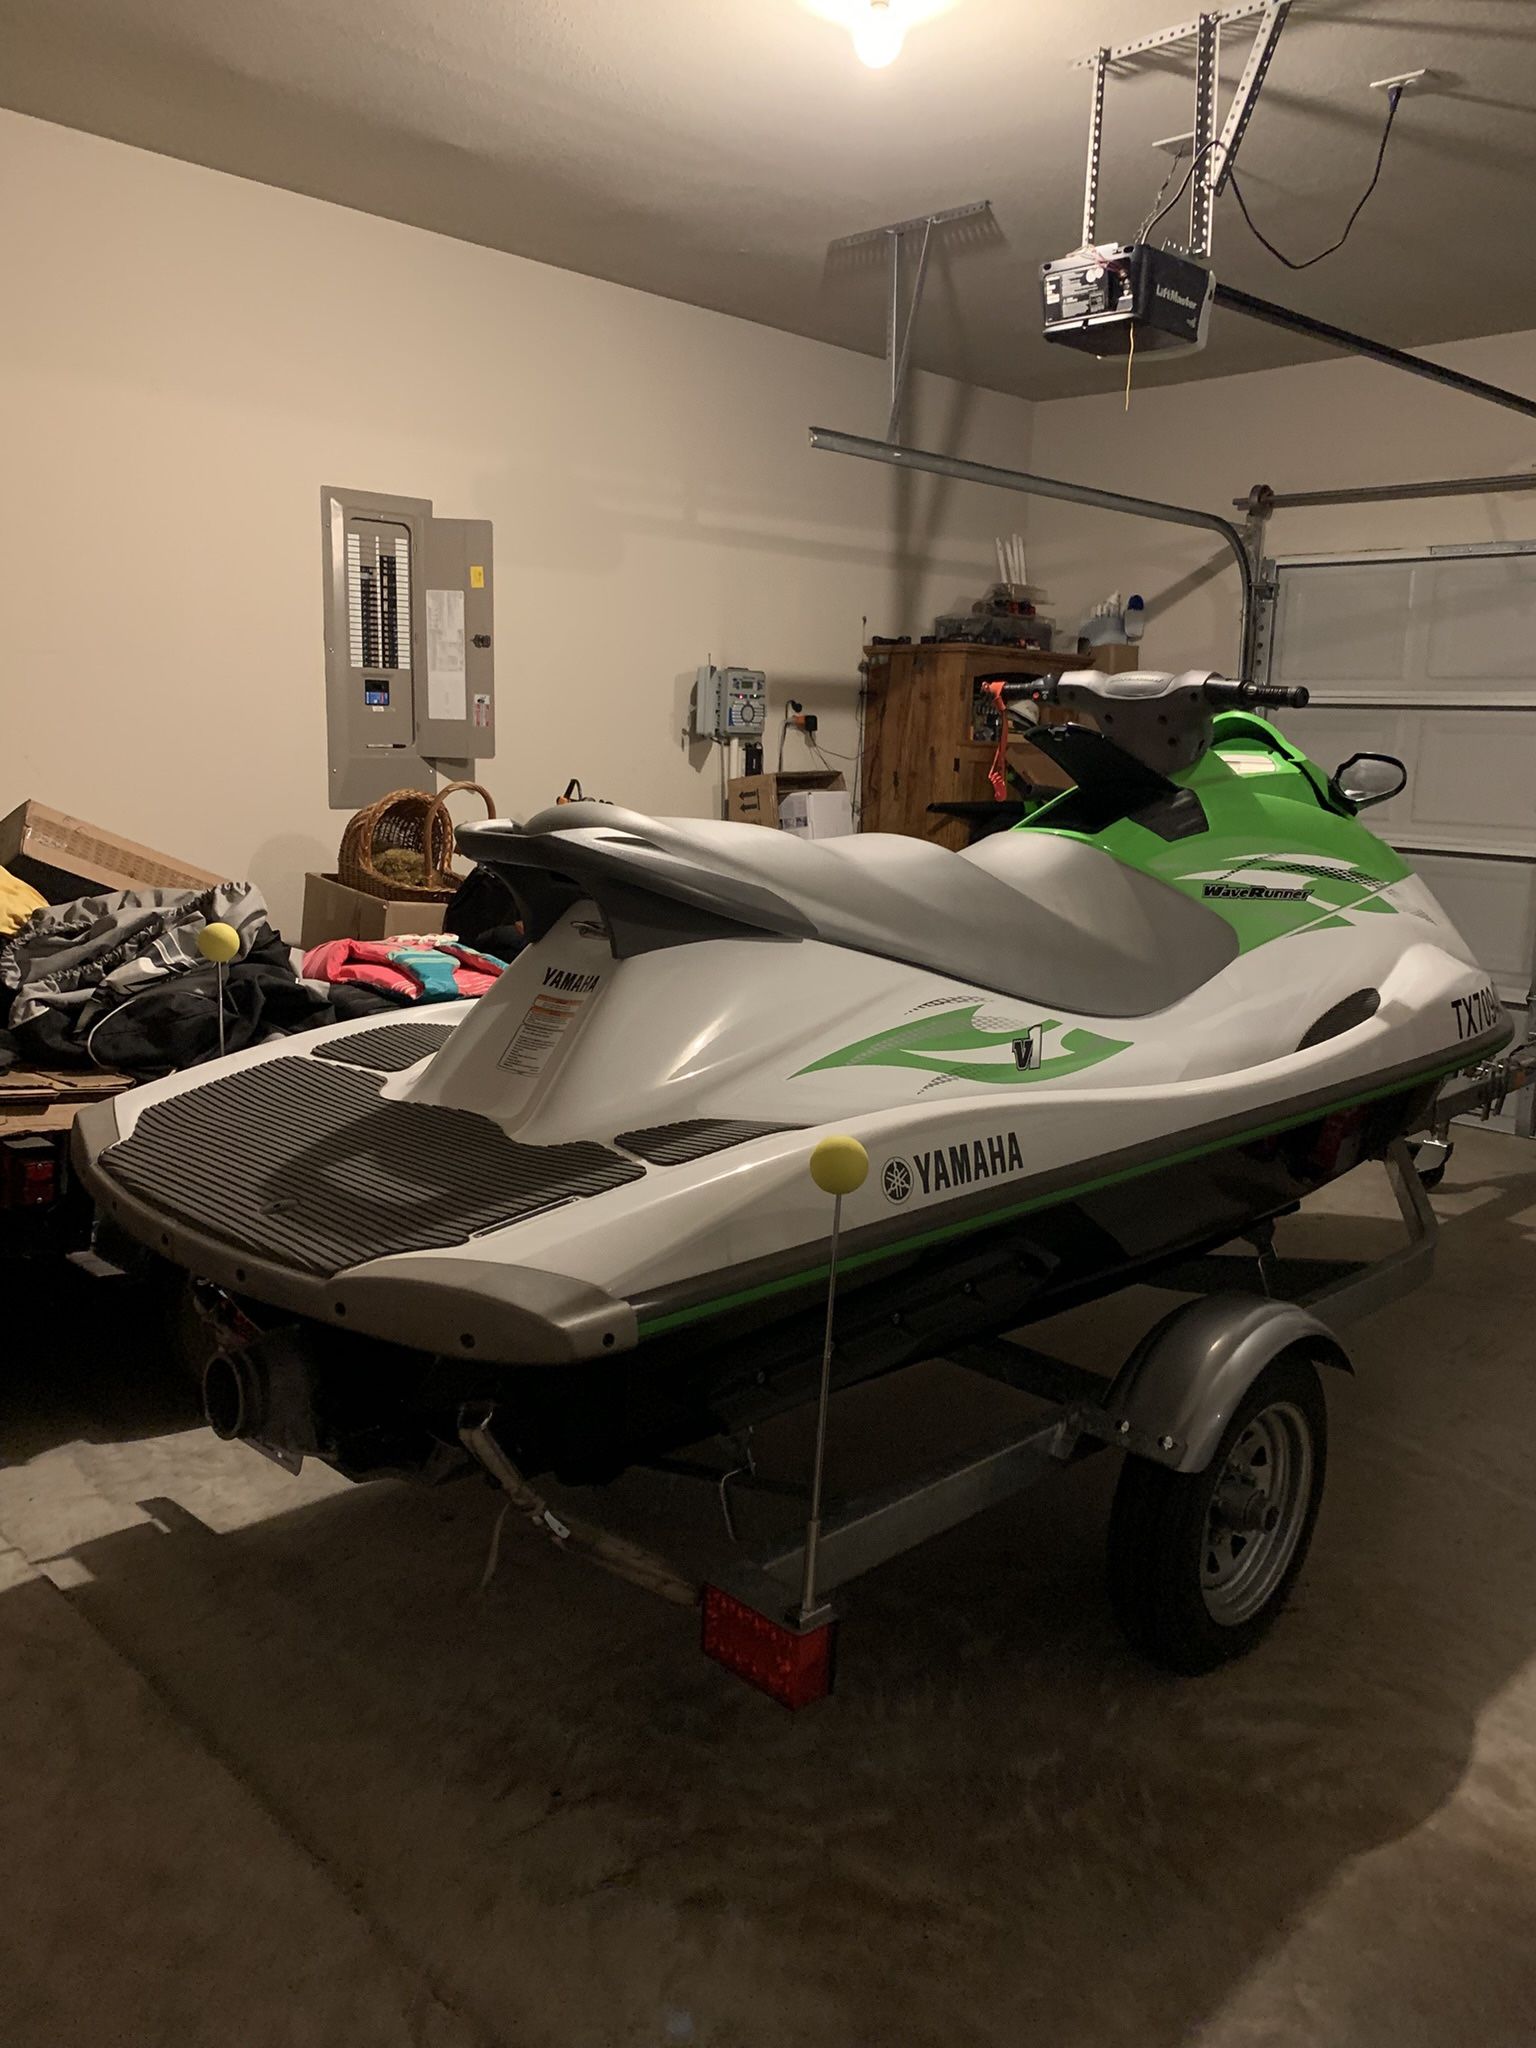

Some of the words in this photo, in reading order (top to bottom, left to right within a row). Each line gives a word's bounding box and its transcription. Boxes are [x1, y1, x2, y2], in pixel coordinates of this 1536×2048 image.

[1156, 284, 1197, 310] LiftMaster
[1203, 884, 1312, 901] WaveRunner
[542, 967, 600, 993] YAMAHA
[913, 1132, 1024, 1194] YAMAHA
